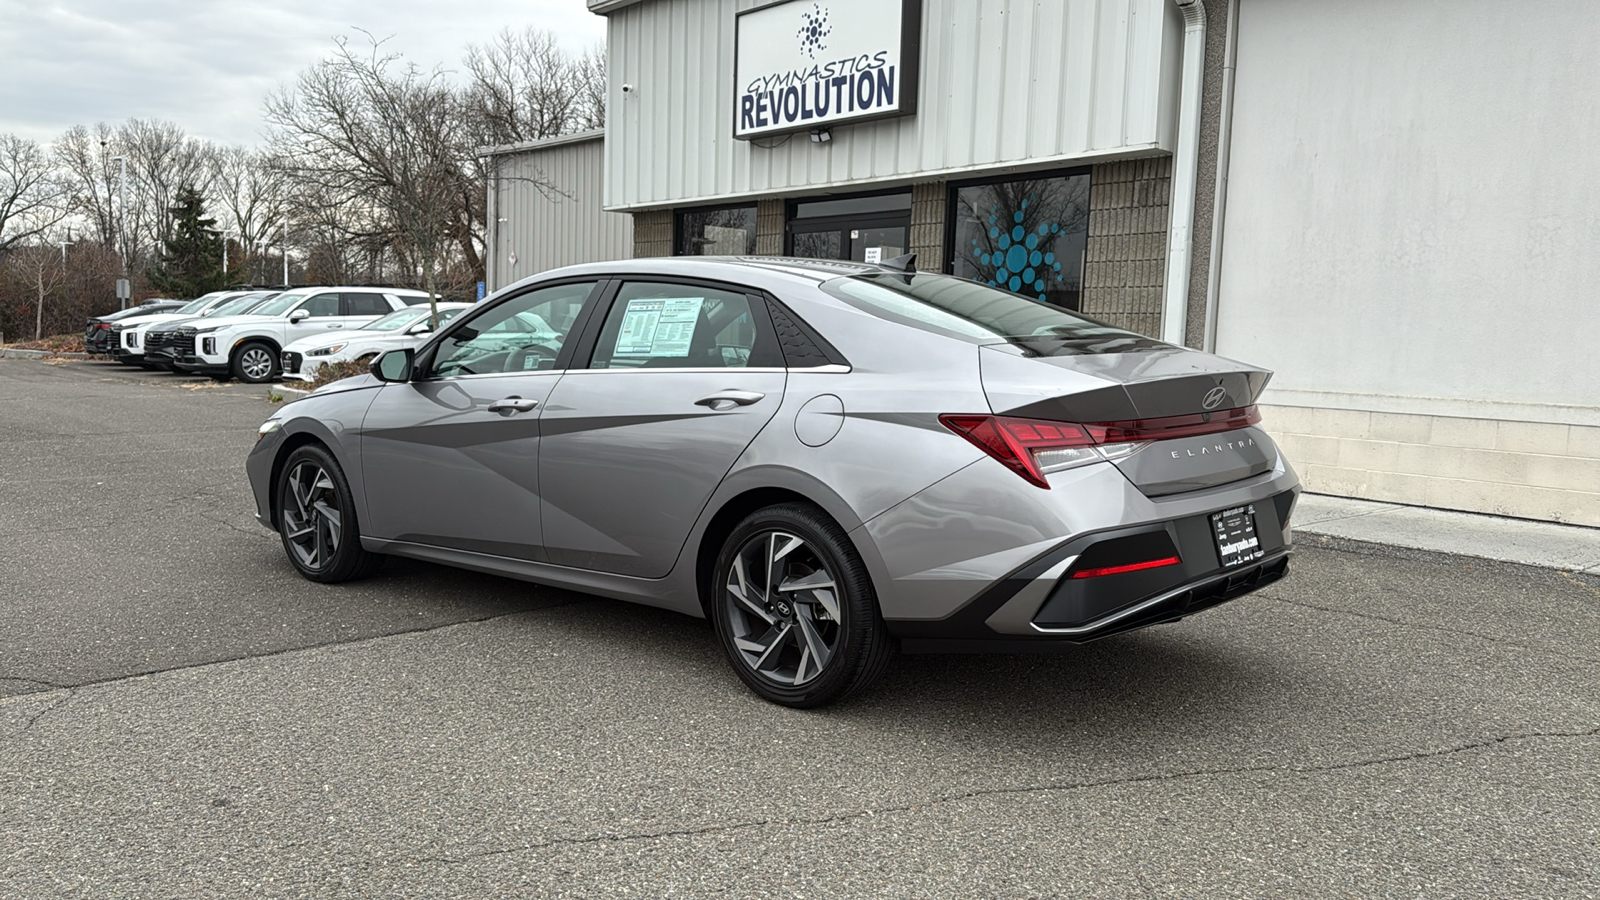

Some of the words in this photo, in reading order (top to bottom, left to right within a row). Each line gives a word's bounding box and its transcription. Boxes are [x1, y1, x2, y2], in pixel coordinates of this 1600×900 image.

[741, 65, 895, 130] REVOLUTION
[747, 51, 887, 98] GYMNASTICS
[1171, 438, 1255, 458] ELANTRA
